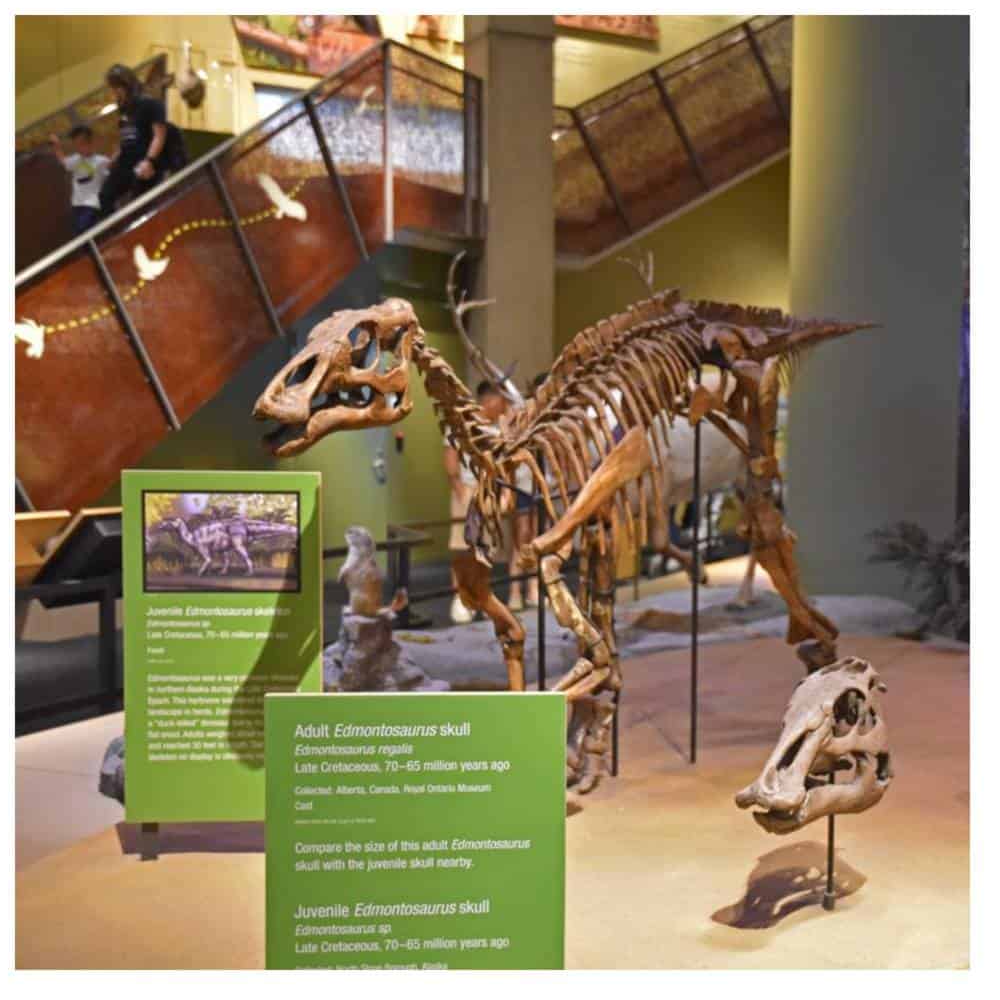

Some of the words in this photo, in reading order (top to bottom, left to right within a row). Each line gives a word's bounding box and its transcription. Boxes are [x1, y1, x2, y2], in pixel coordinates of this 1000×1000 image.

[146, 607, 183, 617] Juvenile
[185, 606, 253, 616] Edmontosaurus
[295, 724, 329, 739] Adult
[334, 723, 437, 738] Edmontosaurus
[440, 721, 471, 737] skull
[295, 743, 376, 756] Edmontosaurus
[378, 743, 413, 757] regalis
[295, 762, 318, 774] Late
[320, 761, 381, 774] Cretaceous,
[424, 760, 458, 771] million
[460, 761, 488, 773] years
[490, 761, 510, 773] ago
[427, 784, 456, 793] Ontario
[457, 784, 492, 793] Museum
[295, 842, 342, 855] Compare
[344, 841, 362, 853] the
[364, 841, 385, 853] size
[387, 840, 399, 852] of
[400, 840, 420, 851] this
[422, 840, 449, 851] adult
[451, 839, 531, 850] Edmontosaurus
[295, 860, 320, 872] skull
[322, 859, 345, 871] with
[347, 859, 365, 871] the
[367, 858, 408, 873] juvenile
[410, 858, 434, 869] skull
[436, 857, 475, 870] nearby.
[294, 903, 350, 919] Juvenile
[354, 901, 457, 917] Edmontosaurus
[459, 899, 490, 914] skull
[295, 924, 376, 936] Edmontosaurus
[295, 942, 318, 953] Late
[320, 941, 382, 953] Cretaceous,
[423, 938, 457, 949] million
[459, 938, 488, 950] years
[489, 938, 510, 950] ago
